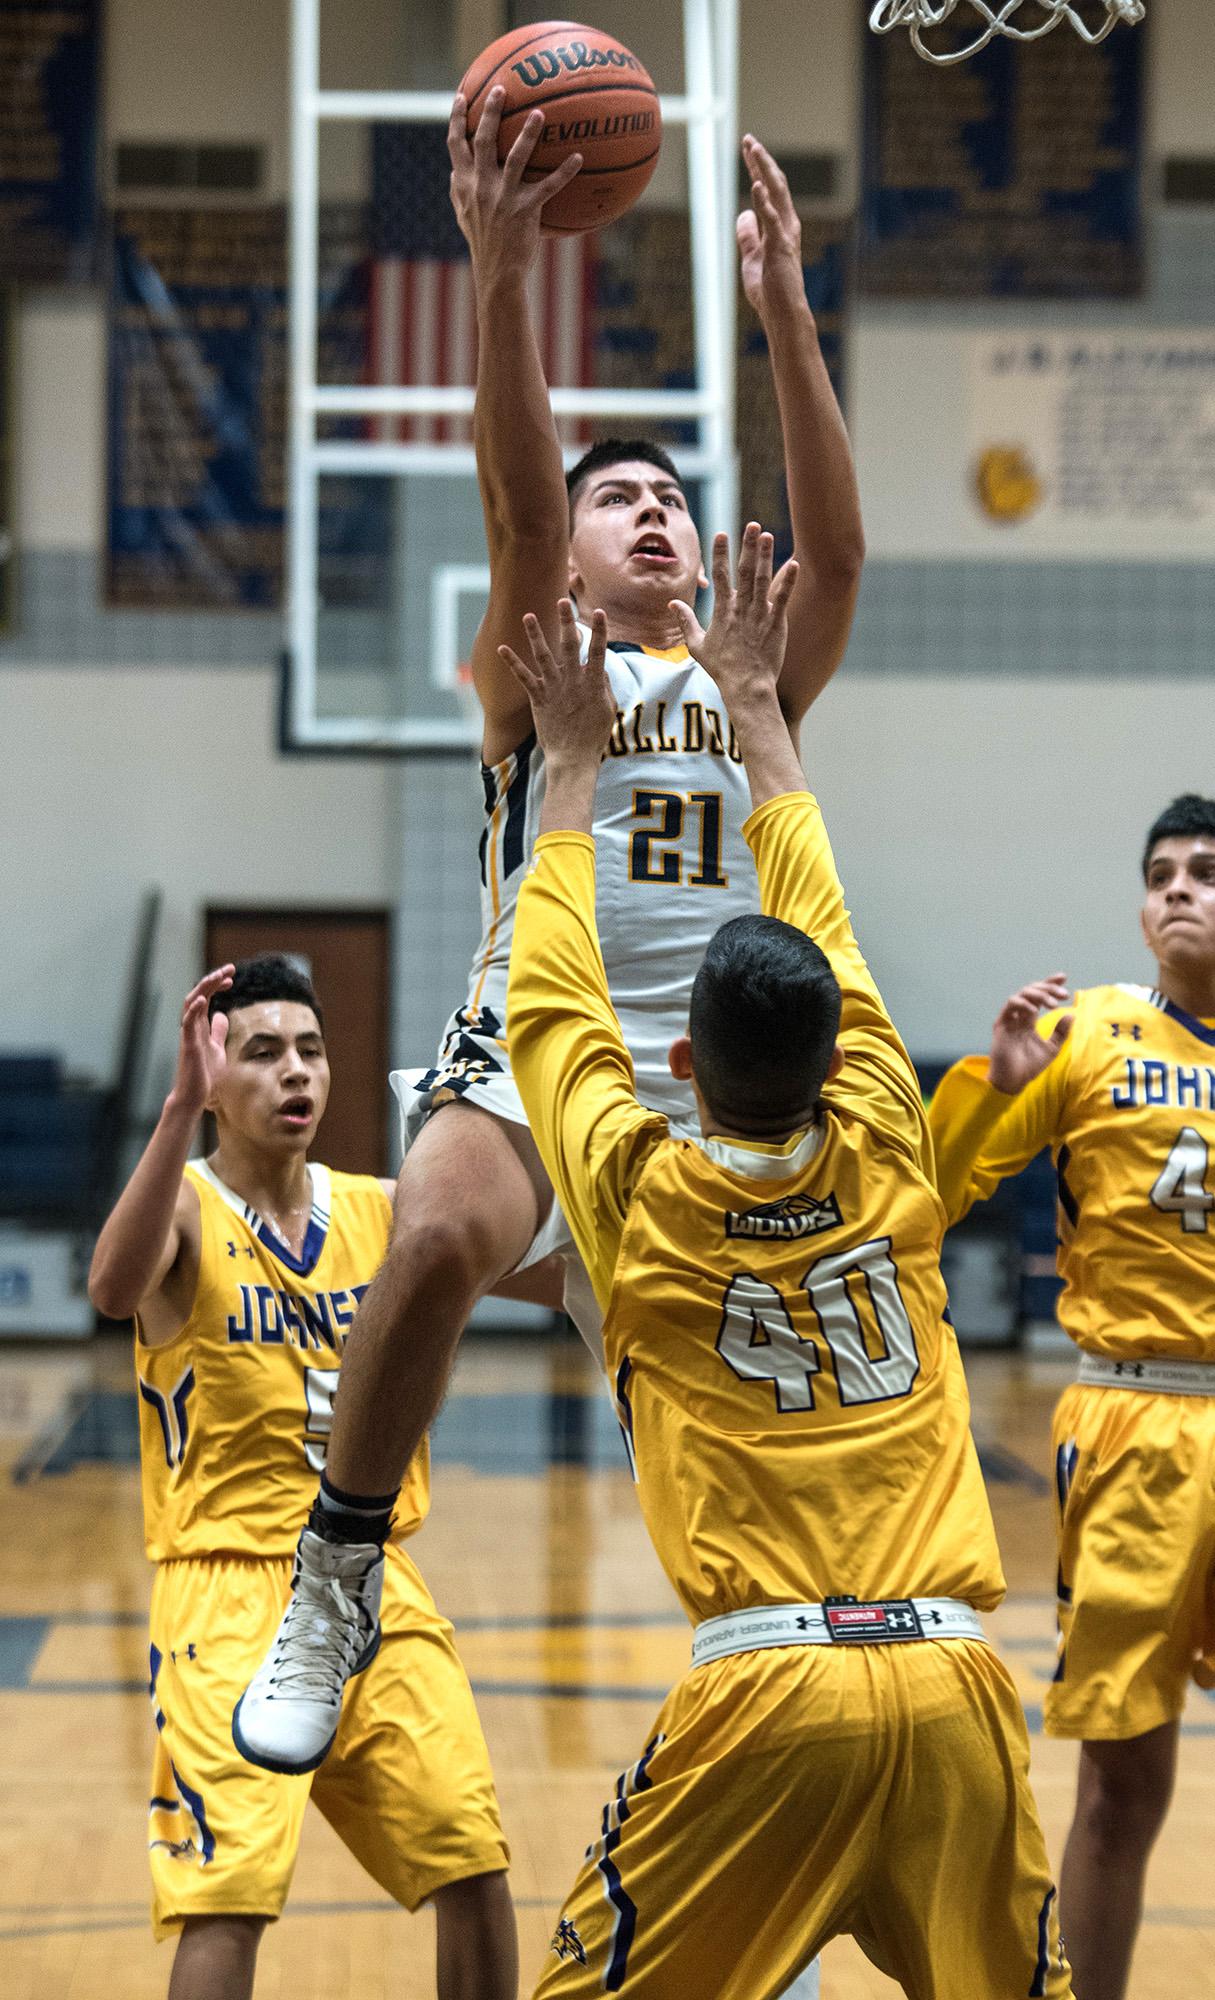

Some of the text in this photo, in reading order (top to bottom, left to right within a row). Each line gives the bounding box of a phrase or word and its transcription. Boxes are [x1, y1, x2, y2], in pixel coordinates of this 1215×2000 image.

[511, 41, 645, 87] Wilson
[540, 111, 655, 143] EVOLUTION
[601, 701, 743, 763] ULLDO
[628, 788, 729, 888] 21
[1149, 1126, 1215, 1234] 4
[715, 1236, 921, 1414] 40
[740, 1620, 791, 1635] UNDER
